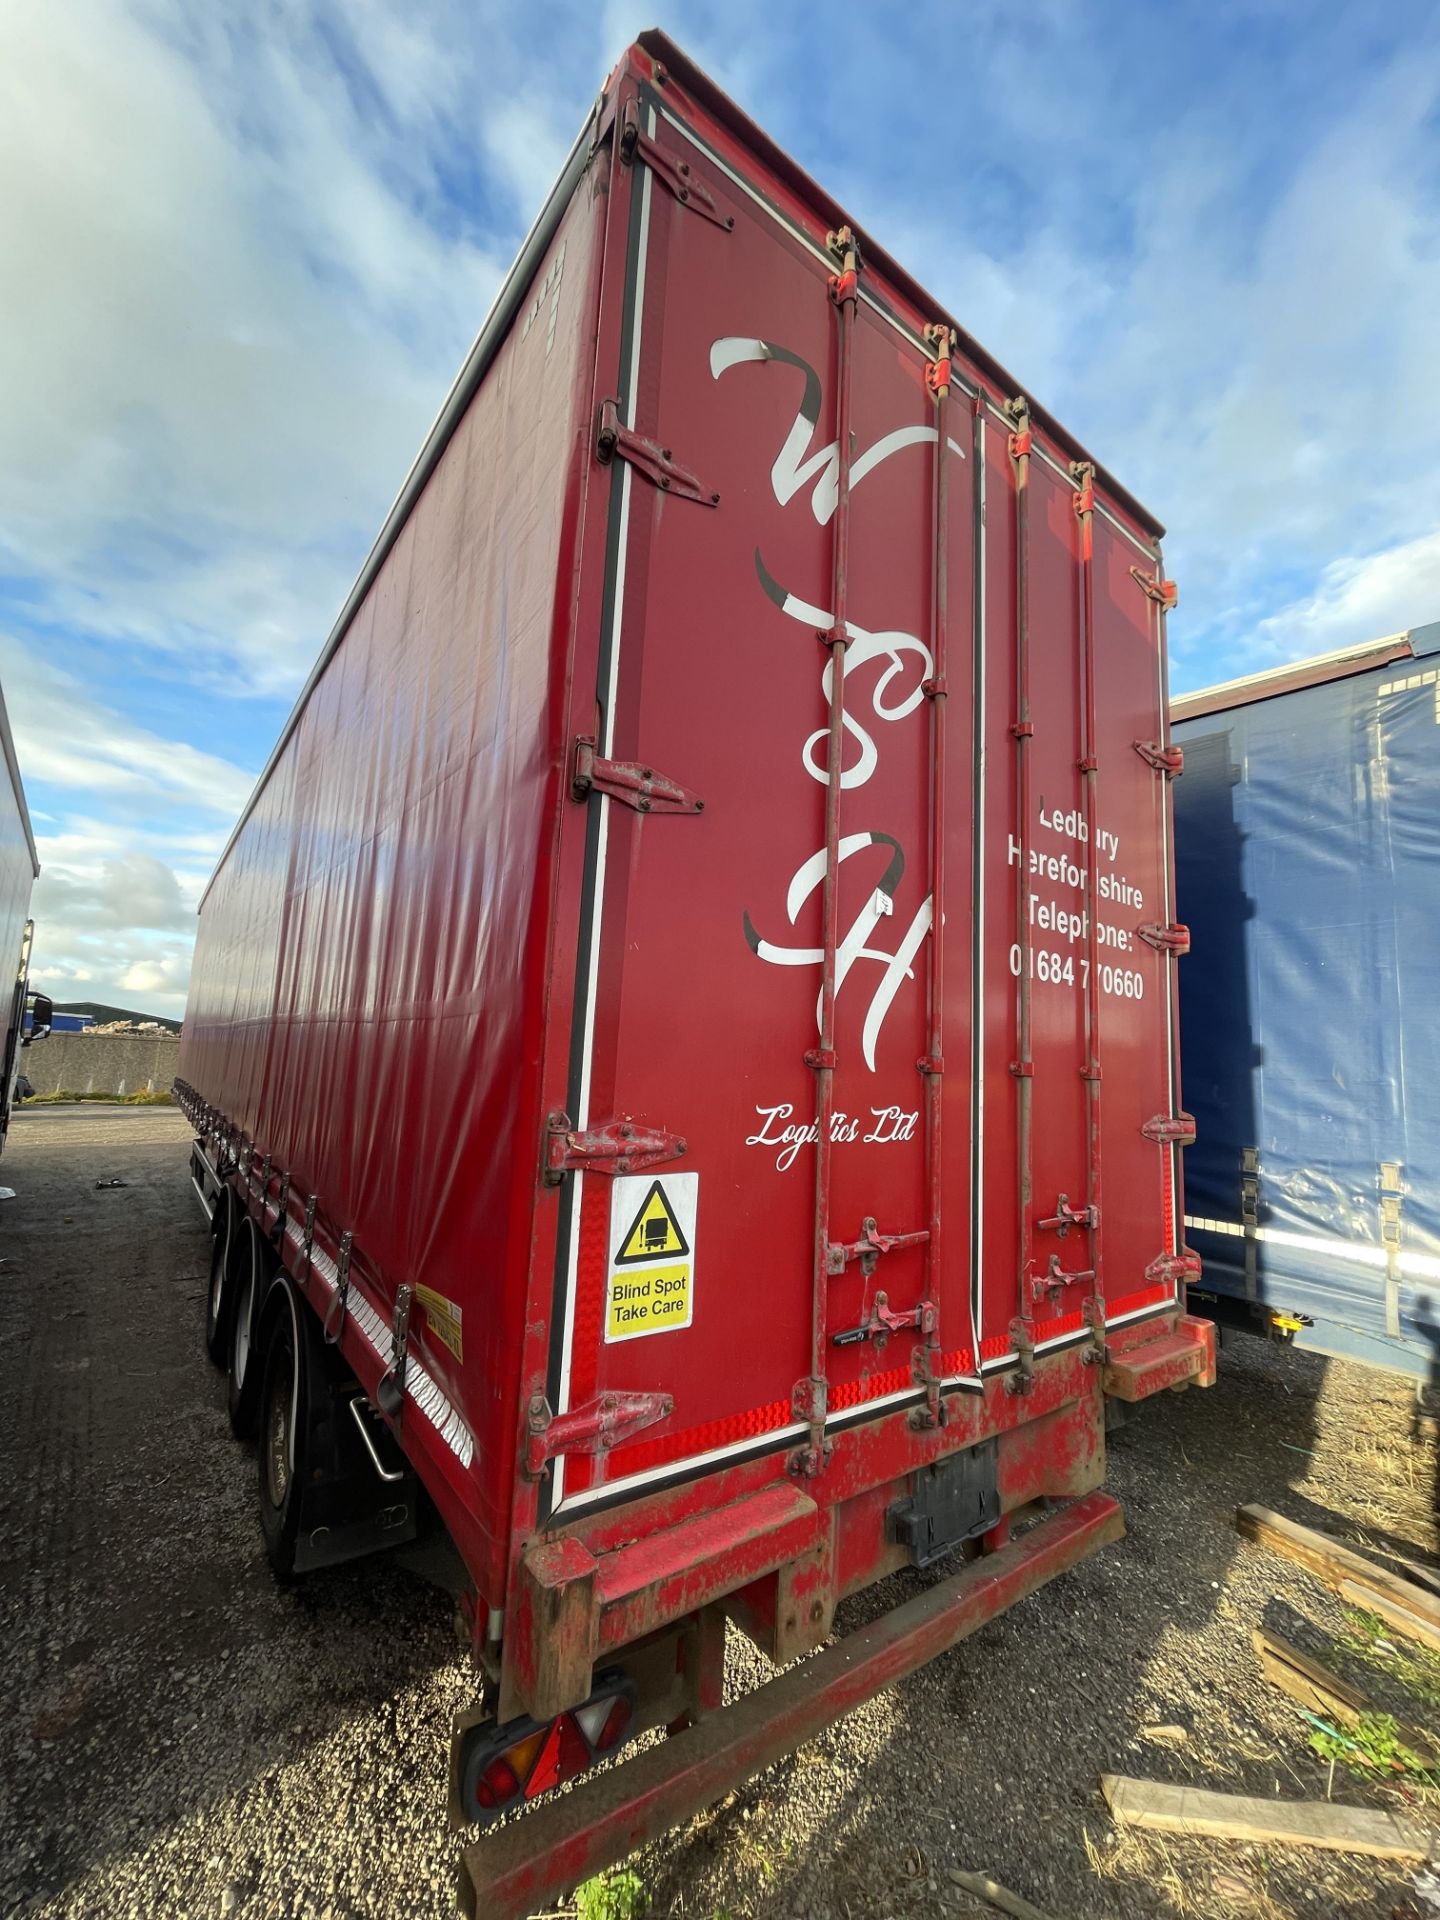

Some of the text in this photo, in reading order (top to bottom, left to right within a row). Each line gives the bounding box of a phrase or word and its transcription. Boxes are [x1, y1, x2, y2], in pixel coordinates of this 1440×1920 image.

[1008, 834, 1143, 910] Hereforshire
[863, 1106, 919, 1143] Ltd
[613, 1276, 686, 1301] Blind Spot
[614, 1299, 684, 1322] Take Care
